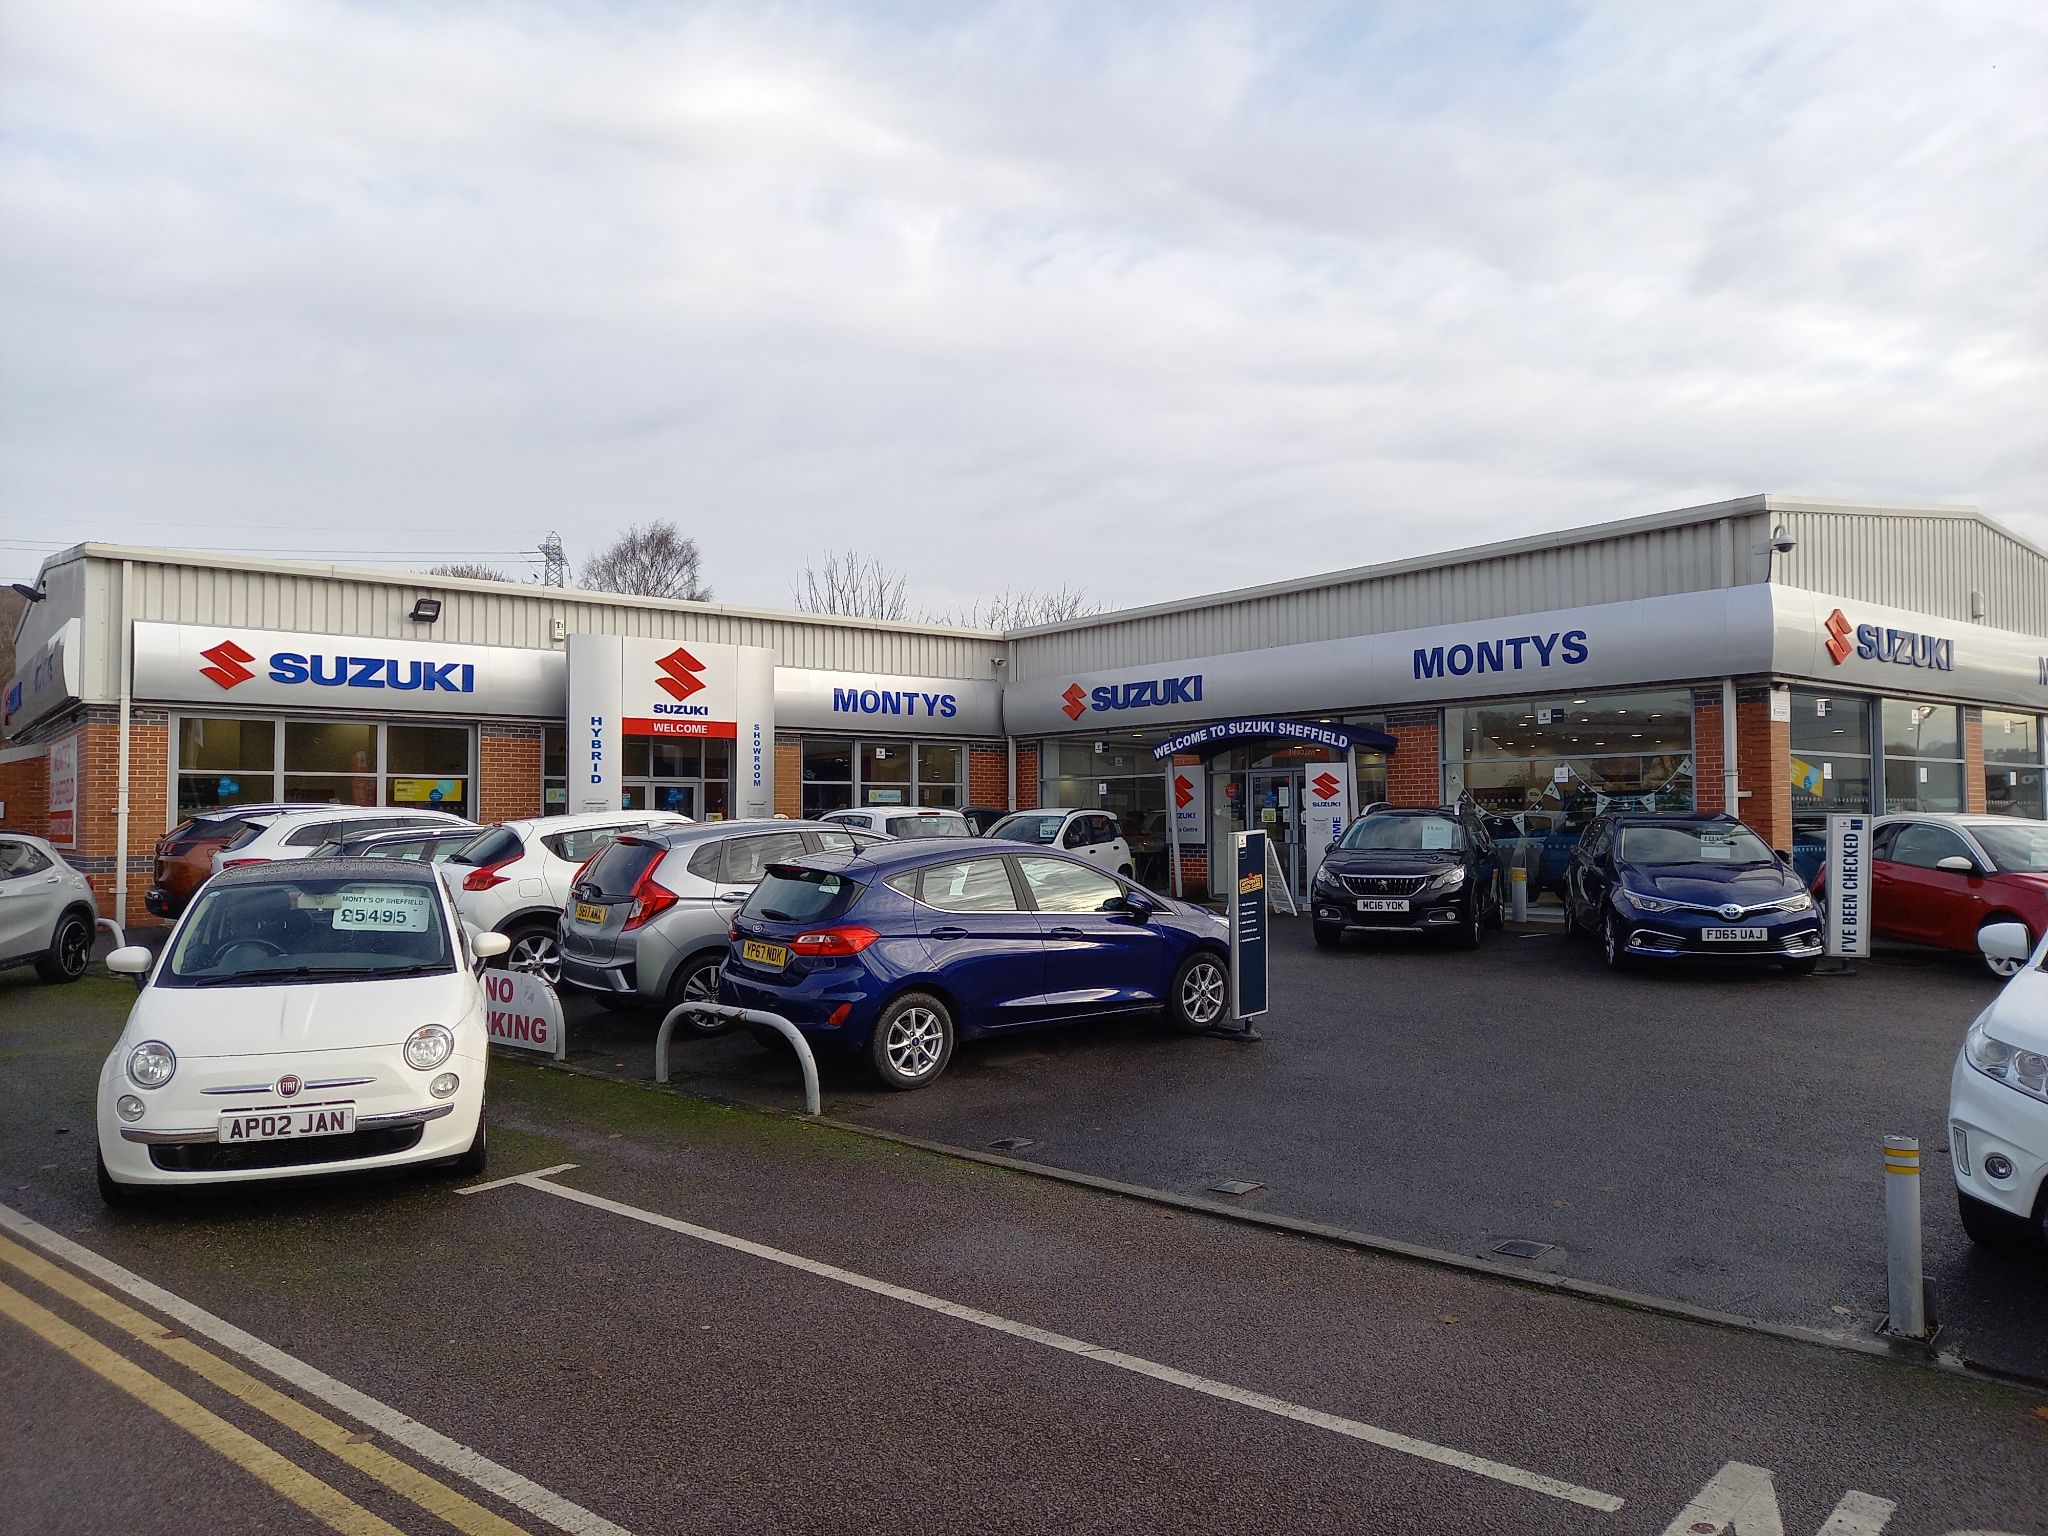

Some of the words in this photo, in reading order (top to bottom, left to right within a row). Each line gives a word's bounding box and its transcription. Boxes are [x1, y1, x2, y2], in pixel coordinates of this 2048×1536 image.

[1413, 630, 1588, 680] MONTYS
[1857, 623, 1954, 671] SUZUKI
[268, 652, 474, 693] SUZUKI
[833, 687, 957, 718] MONTYS
[1091, 674, 1203, 712] SUZUKI
[653, 703, 709, 716] SUZUKI
[653, 722, 709, 734] WELCOME
[1153, 728, 1208, 760] WELCOME
[1209, 725, 1226, 738] TO
[1228, 721, 1275, 735] SUZUKI
[1277, 722, 1348, 749] SHEFFIELD
[591, 716, 602, 784] HYBRID
[753, 723, 761, 787] SHOWROOM
[1842, 833, 1859, 890] CHECKED
[340, 908, 407, 924] £5495
[386, 898, 424, 906] SHEFFIELD
[1362, 901, 1384, 910] MC16
[1842, 894, 1858, 926] BEEN
[1706, 929, 1738, 940] FD65
[1740, 929, 1763, 940] UAJ
[1841, 929, 1857, 953] I'VE
[747, 942, 766, 958] YP67
[766, 947, 783, 963] NDK
[485, 975, 514, 1004] NO
[282, 1081, 296, 1092] FIAT
[229, 1115, 292, 1139] AP02
[299, 1110, 345, 1134] JAN
